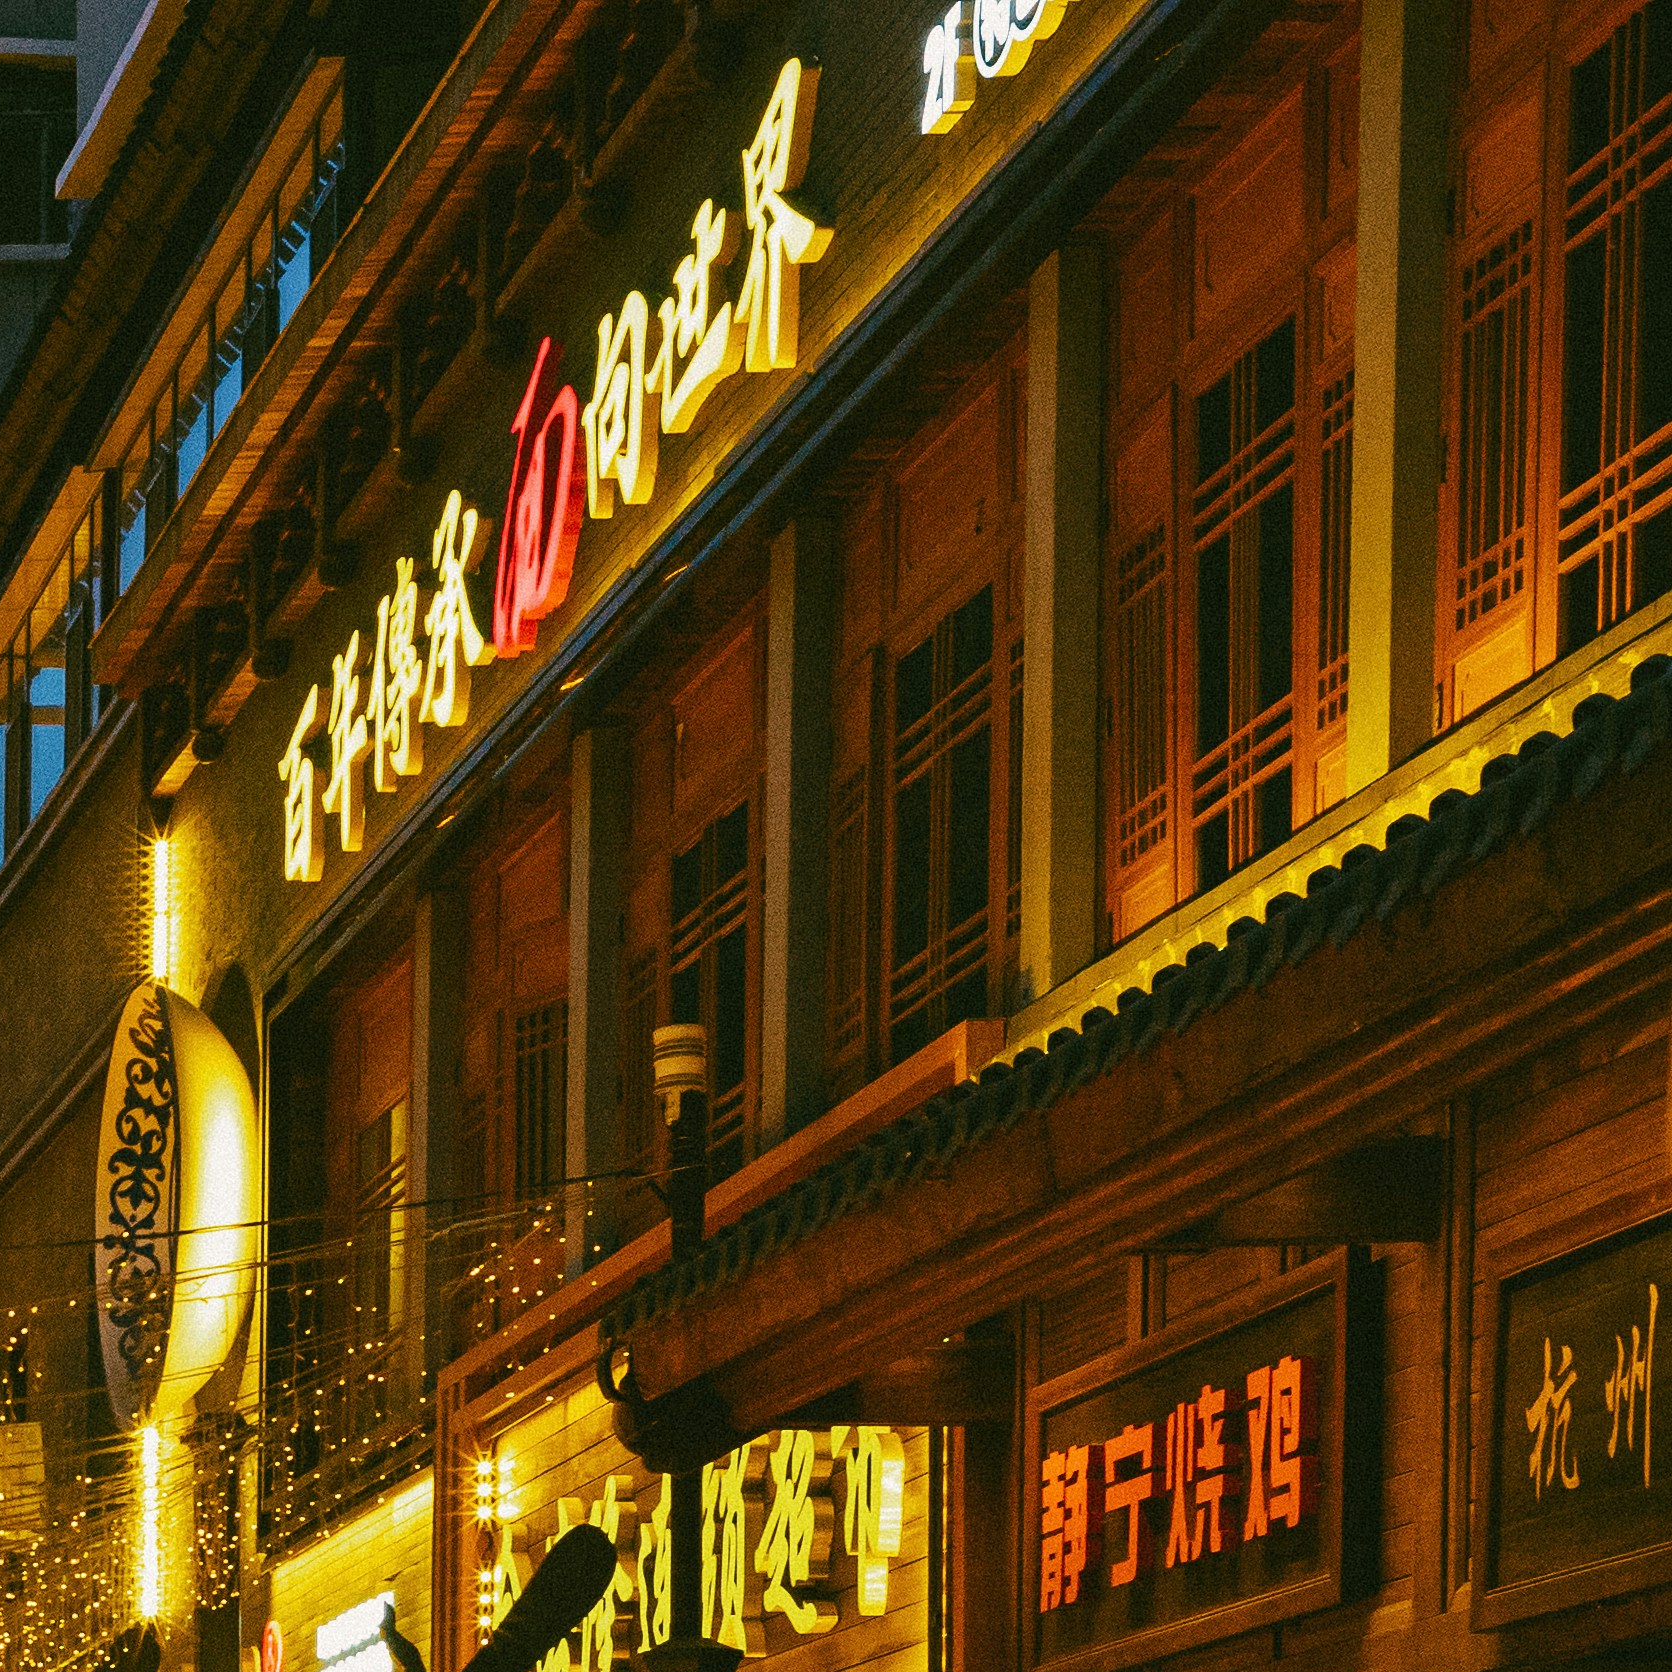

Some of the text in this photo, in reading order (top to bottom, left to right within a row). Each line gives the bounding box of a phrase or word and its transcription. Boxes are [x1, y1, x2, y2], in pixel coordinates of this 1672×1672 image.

[1039, 1354, 1303, 1613] 静宁烧鸡
[1524, 1283, 1656, 1499] 杭州
